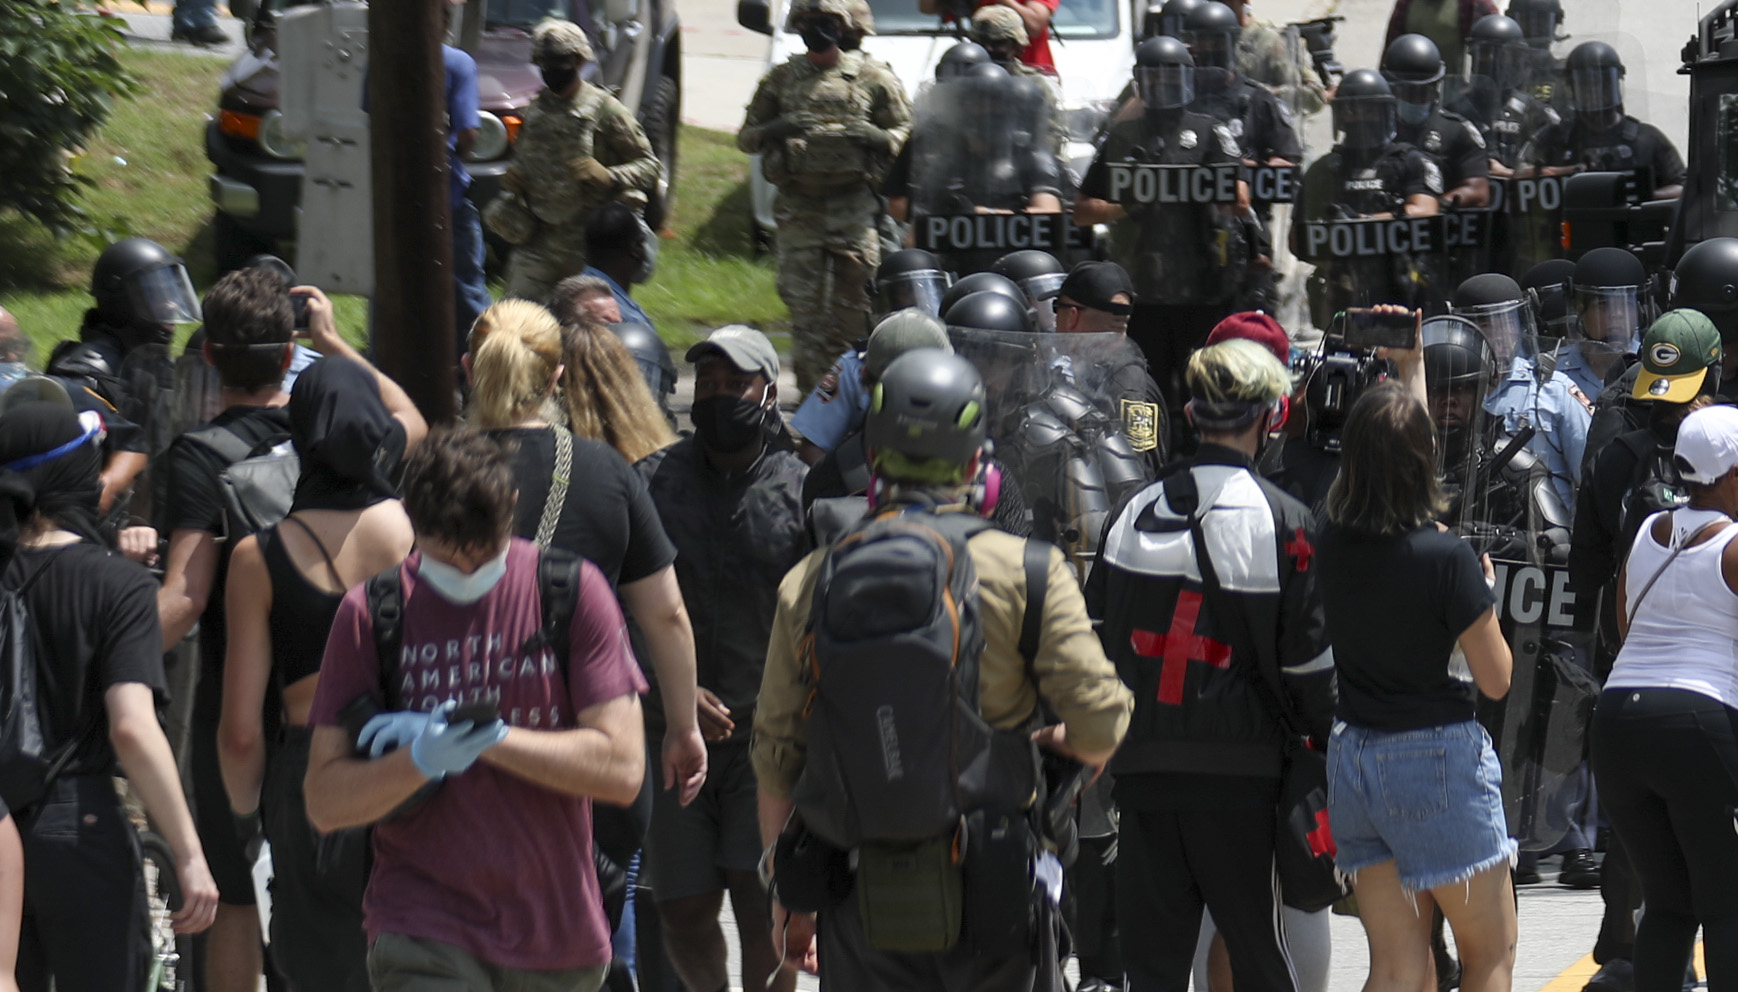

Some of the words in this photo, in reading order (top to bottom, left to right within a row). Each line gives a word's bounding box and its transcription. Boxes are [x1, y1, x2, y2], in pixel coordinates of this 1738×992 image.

[1109, 166, 1237, 203] POLICE
[1250, 166, 1294, 200] ICE
[1345, 178, 1383, 191] POLICE
[927, 215, 1052, 249] POLICE
[1307, 218, 1433, 256] POLICE
[1494, 564, 1577, 626] ICE
[401, 632, 502, 665] NORTH
[402, 653, 556, 690] AMERICAN
